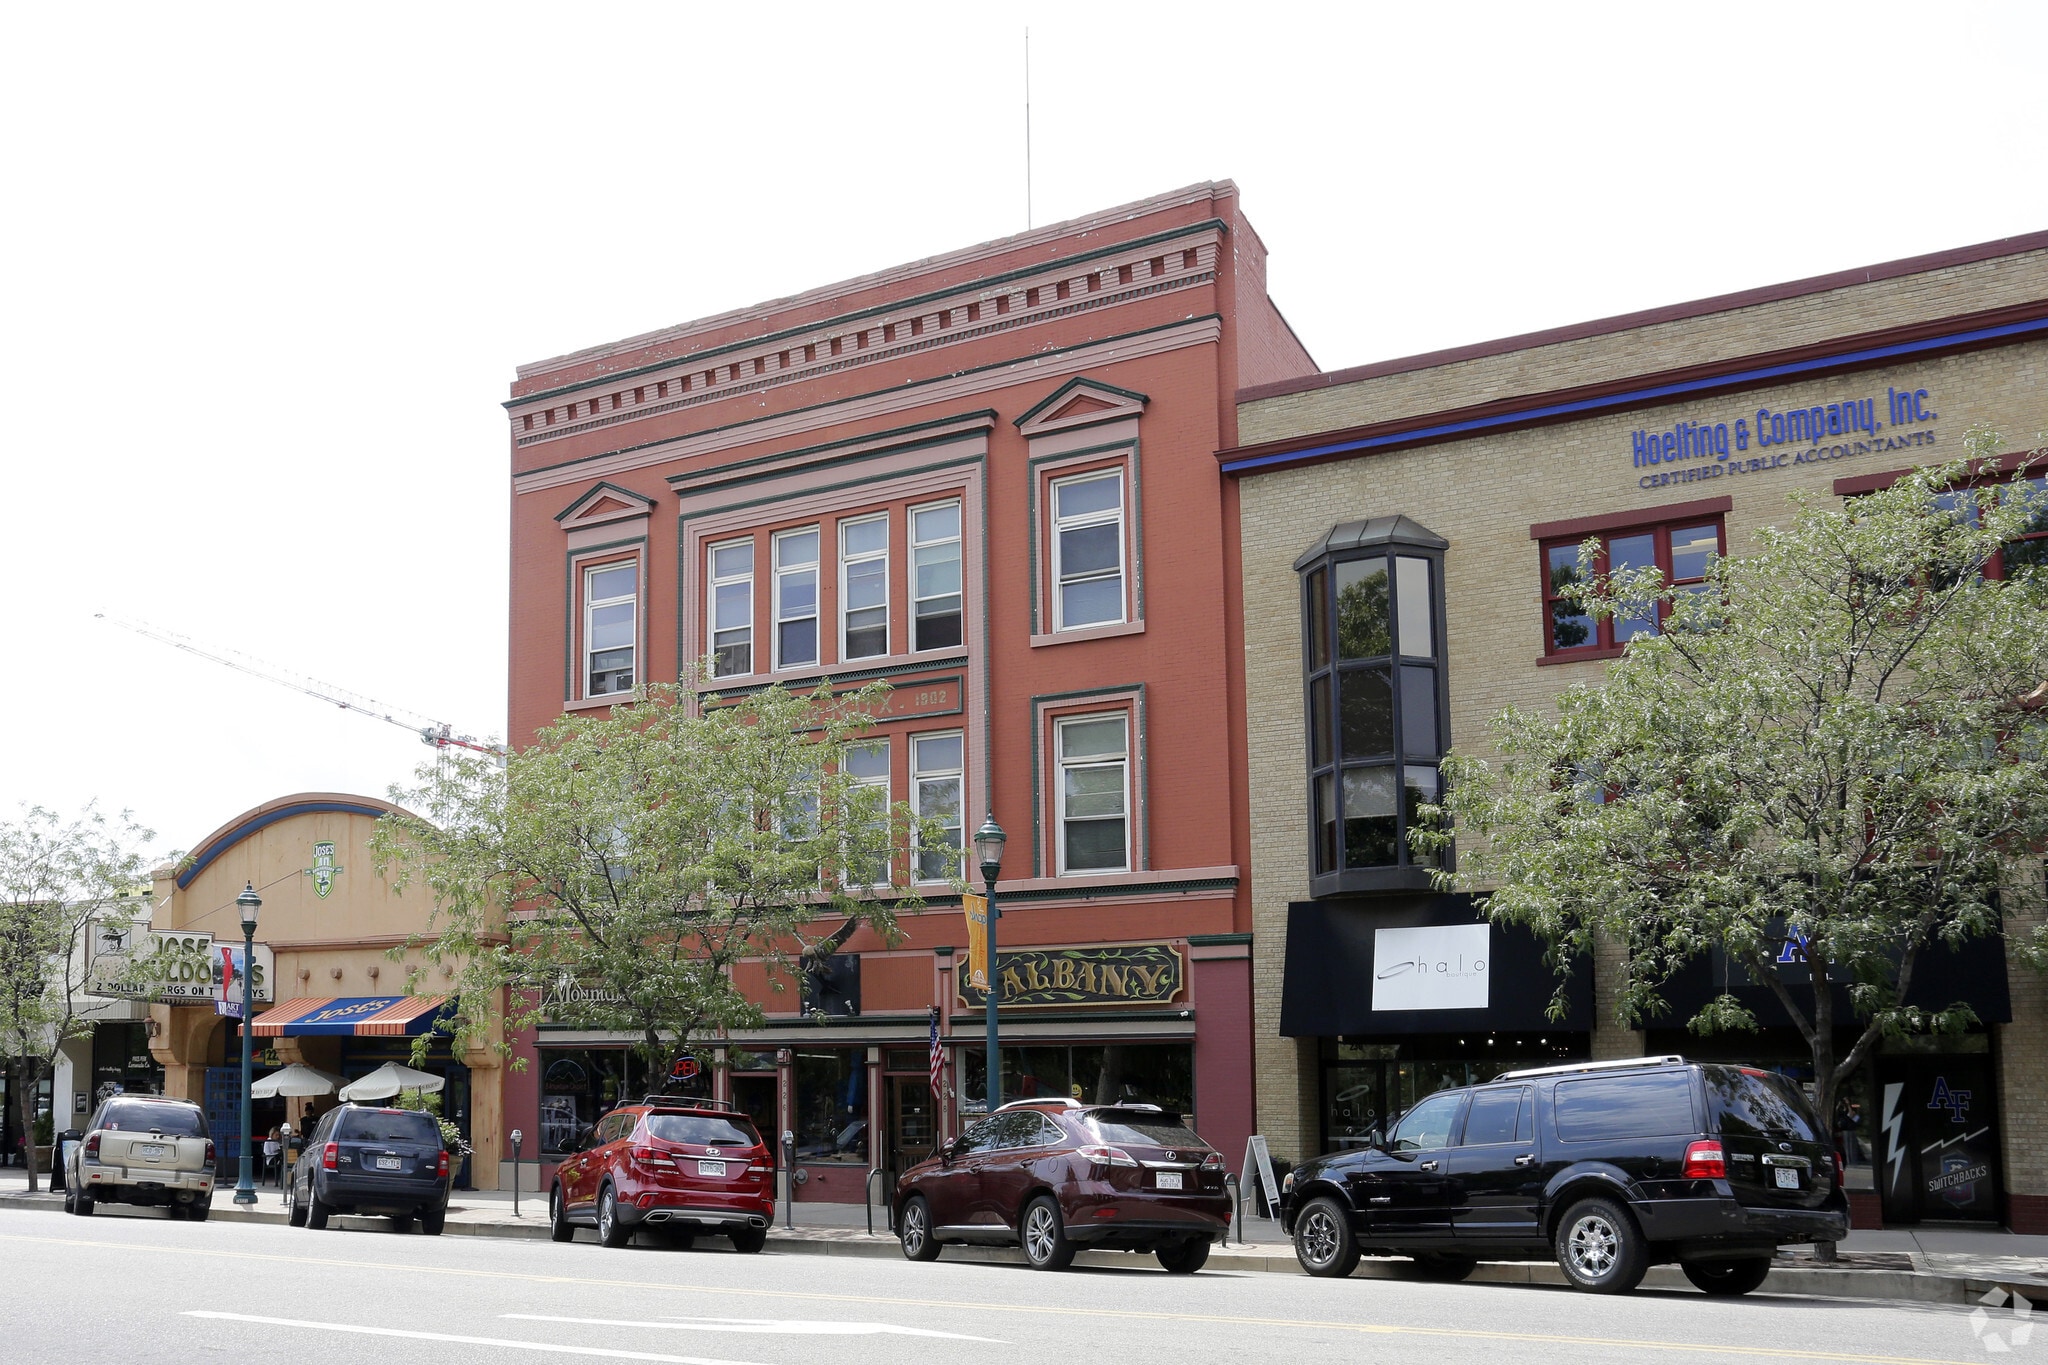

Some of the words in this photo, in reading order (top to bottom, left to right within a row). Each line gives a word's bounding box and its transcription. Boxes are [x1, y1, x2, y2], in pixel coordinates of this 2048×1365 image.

[1632, 420, 1729, 468] Hoelting
[1735, 418, 1750, 450] &
[1756, 397, 1882, 447] Company,
[1888, 387, 1938, 426] Inc.
[1639, 464, 1724, 489] CERTIFIED
[1728, 453, 1789, 475] PUBLIC
[1793, 430, 1936, 465] ACCOUNTANTS
[915, 690, 947, 706] 1902
[1417, 953, 1486, 974] halo
[1446, 971, 1477, 979] boutique
[191, 986, 204, 996] ON
[1002, 958, 1169, 1000] ALBANY
[1330, 1103, 1376, 1117] halo
[1927, 1076, 1972, 1123] AF
[1928, 1165, 1988, 1192] SWITCHBACKS
